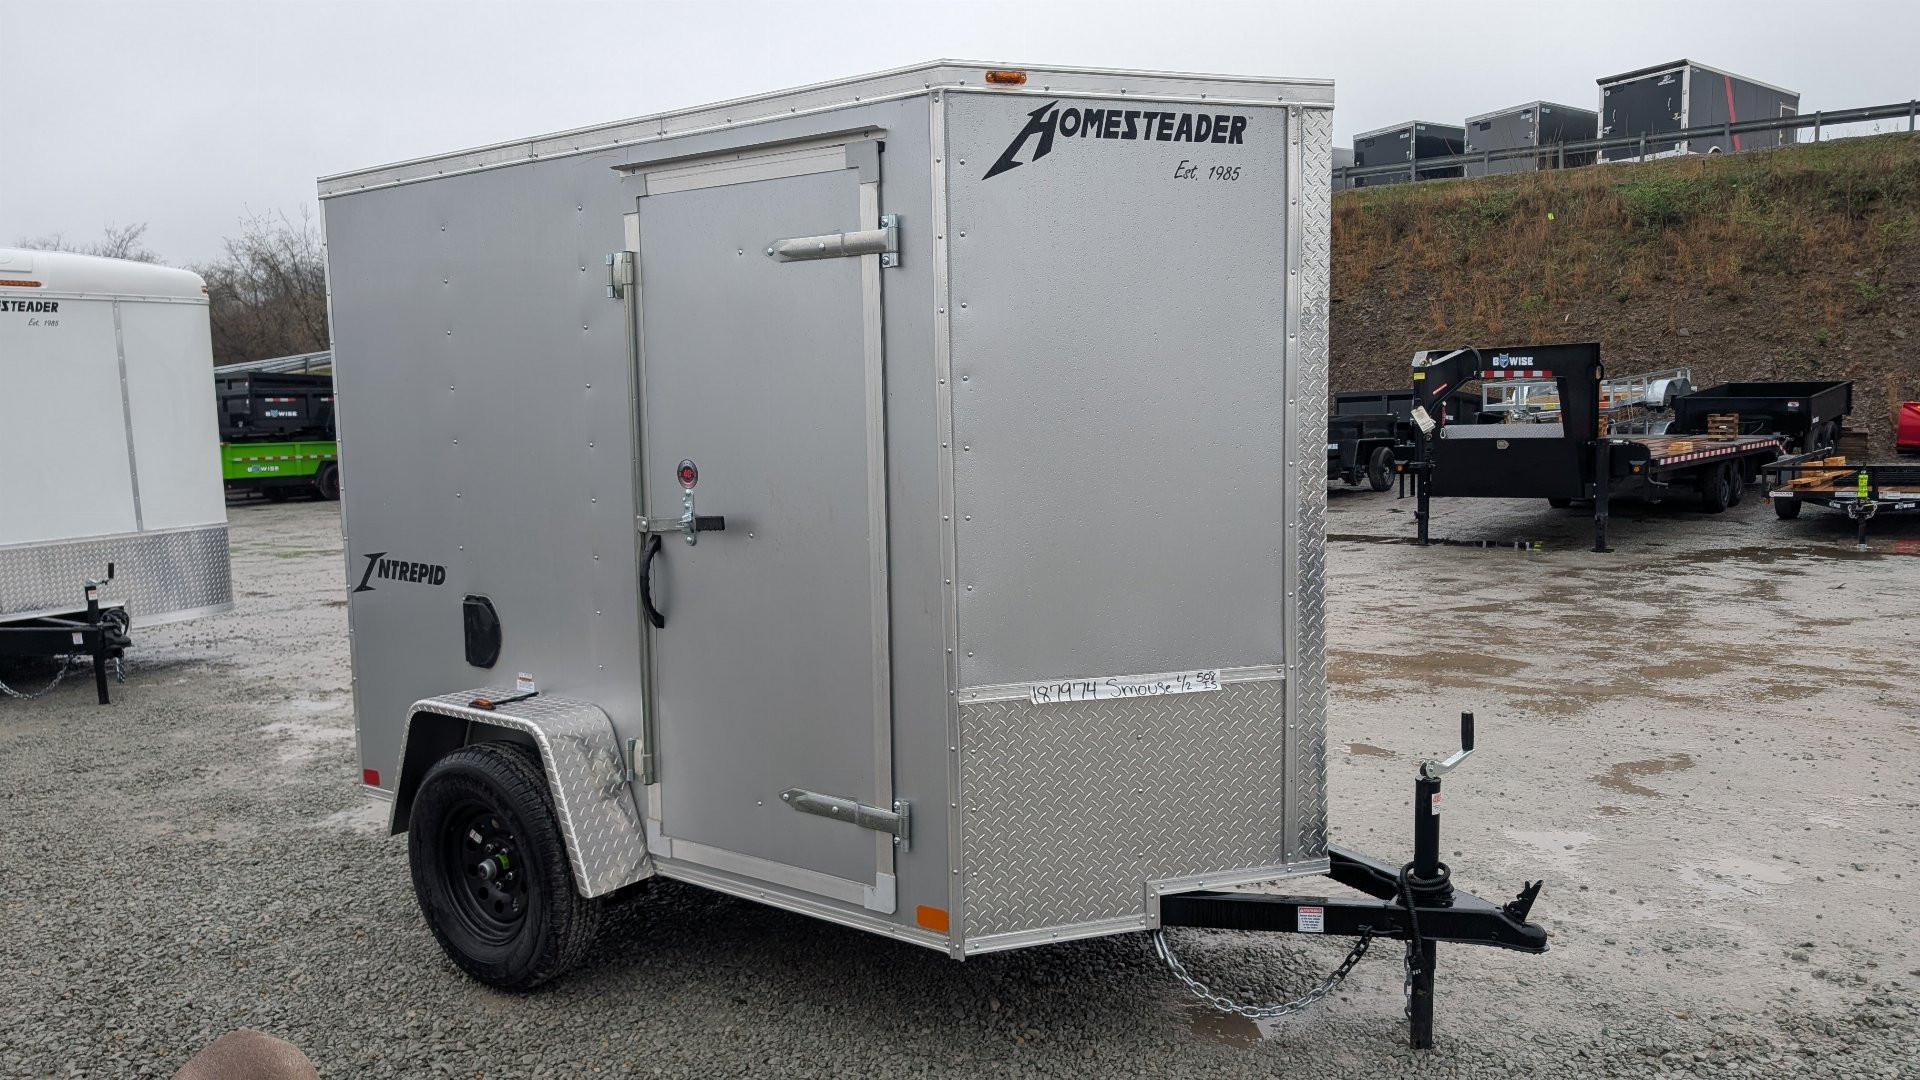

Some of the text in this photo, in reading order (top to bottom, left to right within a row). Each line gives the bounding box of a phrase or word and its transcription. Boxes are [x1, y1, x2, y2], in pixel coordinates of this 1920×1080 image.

[981, 100, 1247, 180] HOMESTEADER
[1174, 160, 1241, 181] Est. 1985
[0, 300, 59, 312] STEADER
[352, 551, 446, 593] INTREPID
[1032, 681, 1097, 704] 187974
